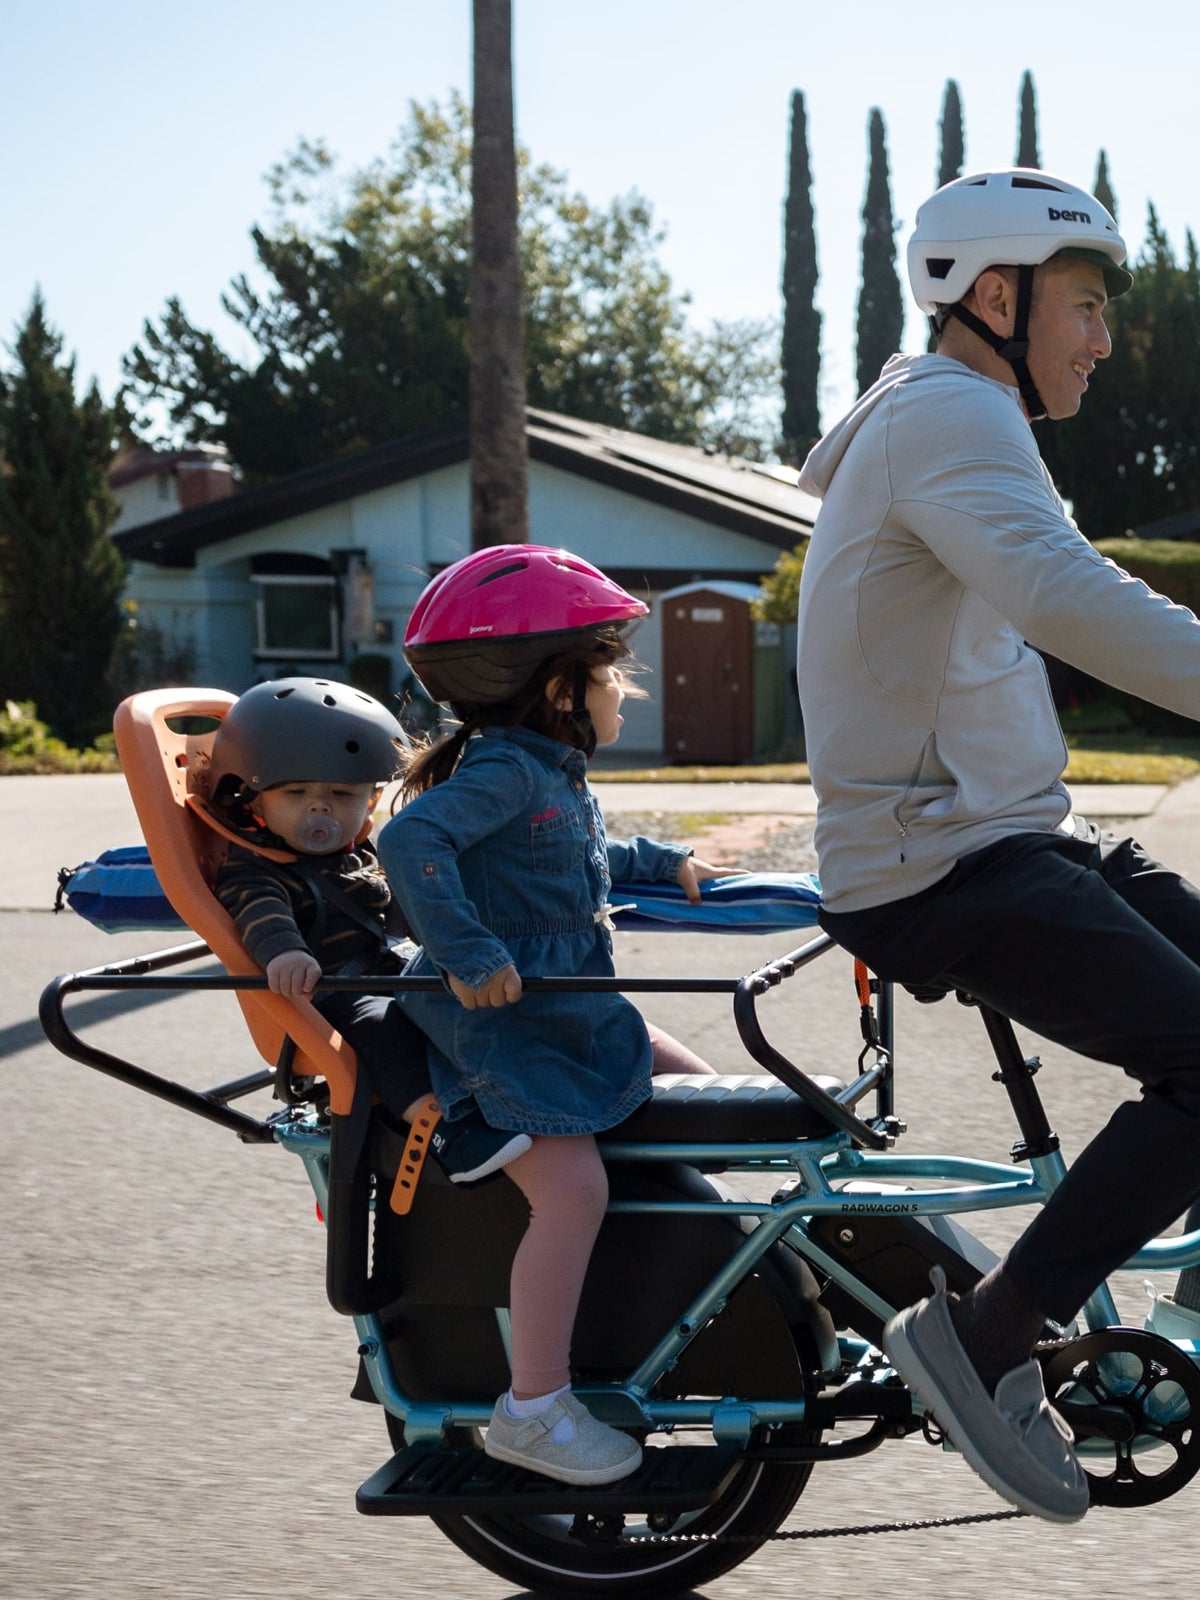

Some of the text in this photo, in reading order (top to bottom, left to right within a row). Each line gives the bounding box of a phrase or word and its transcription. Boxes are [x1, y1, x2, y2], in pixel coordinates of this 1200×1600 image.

[1048, 207, 1091, 224] bern
[841, 1203, 918, 1213] RADWAGON 5
